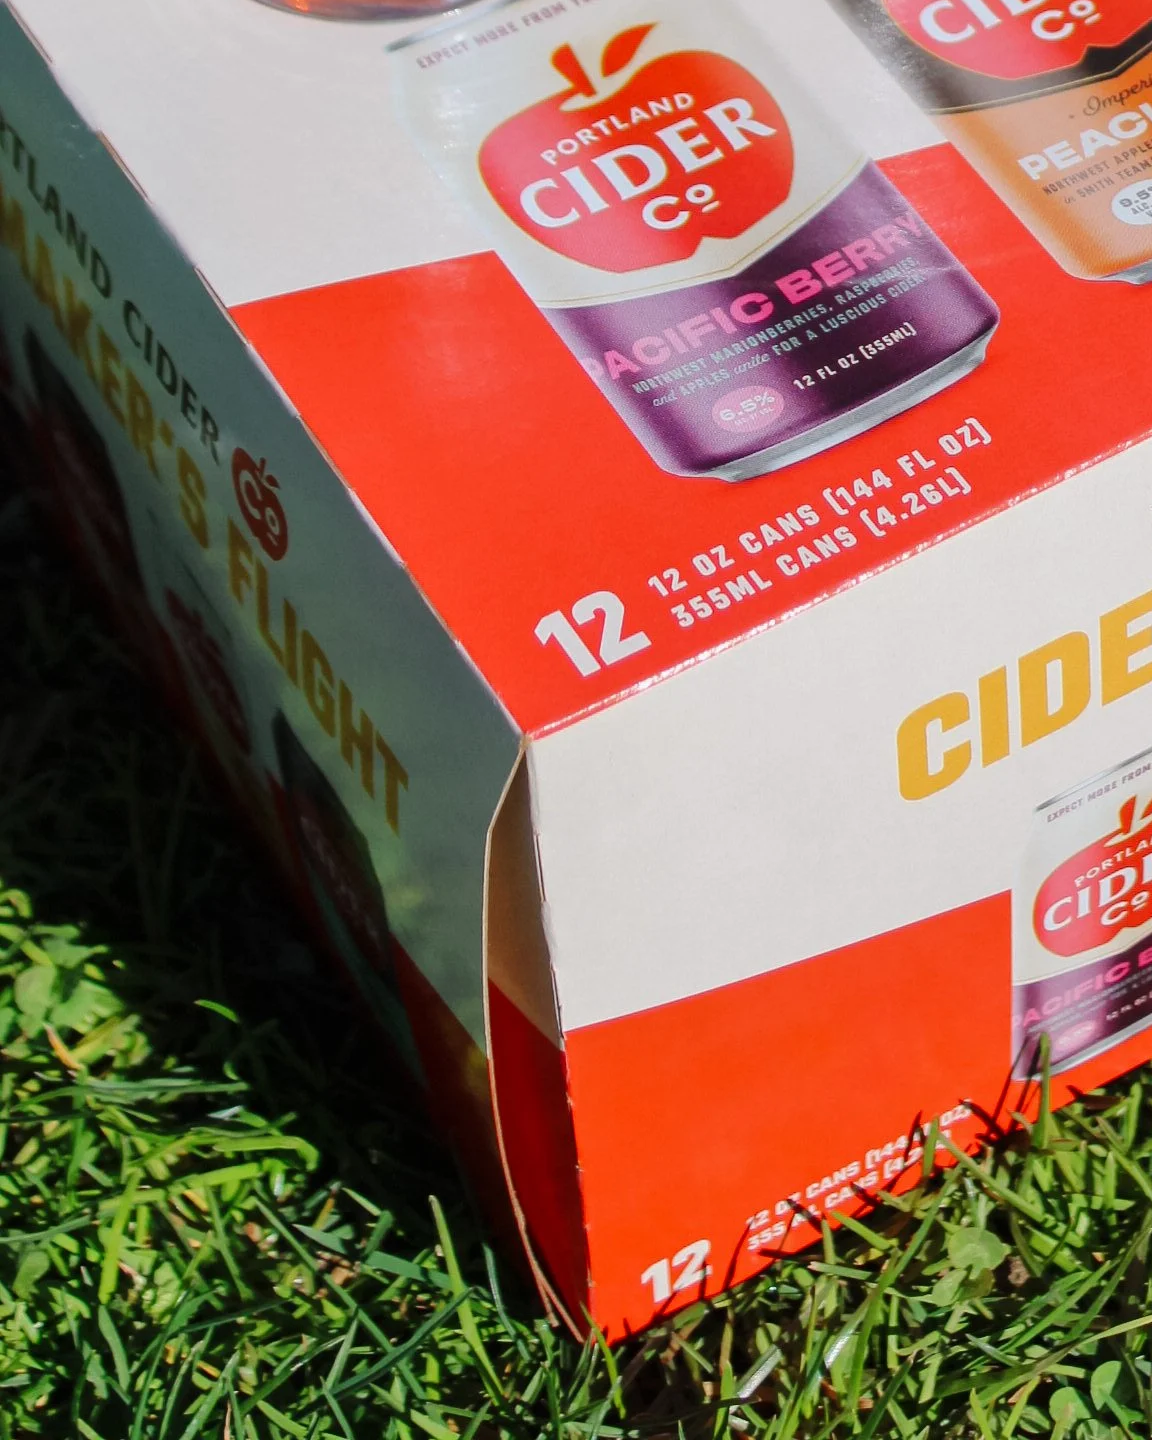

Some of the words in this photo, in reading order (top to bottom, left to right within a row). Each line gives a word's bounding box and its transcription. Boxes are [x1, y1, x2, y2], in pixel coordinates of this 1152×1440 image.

[416, 42, 470, 70] EXPECT
[473, 21, 520, 47] MORE
[521, 2, 568, 27] FROM
[520, 98, 777, 228] CIDER
[540, 92, 695, 165] PORTLAND
[1042, 162, 1110, 196] NORTHWEST
[1076, 176, 1117, 198] SMITH
[775, 214, 922, 304] BERRY
[123, 299, 220, 466] CIDER
[632, 359, 707, 394] NORTHWEST
[653, 390, 677, 406] and
[679, 368, 731, 396] APPLES
[772, 336, 802, 356] FOR
[806, 329, 818, 341] A
[819, 293, 887, 333] LUSCIOUS
[793, 375, 816, 390] 12
[817, 365, 837, 380] FL
[837, 353, 859, 369] OZ
[720, 391, 775, 421] 6.5%
[648, 567, 688, 598] 12
[692, 545, 736, 577] OZ
[739, 503, 820, 555] CANS
[896, 449, 936, 477] FL
[671, 570, 773, 627] 355ML
[775, 526, 857, 577] CANS
[534, 591, 652, 677] 12
[227, 516, 409, 838] FLIGHT
[1047, 798, 1082, 823] EXPECT
[1088, 780, 1118, 802] MORE
[1122, 763, 1151, 784] FROM
[805, 1161, 861, 1199] CANS
[641, 1239, 712, 1303] 12
